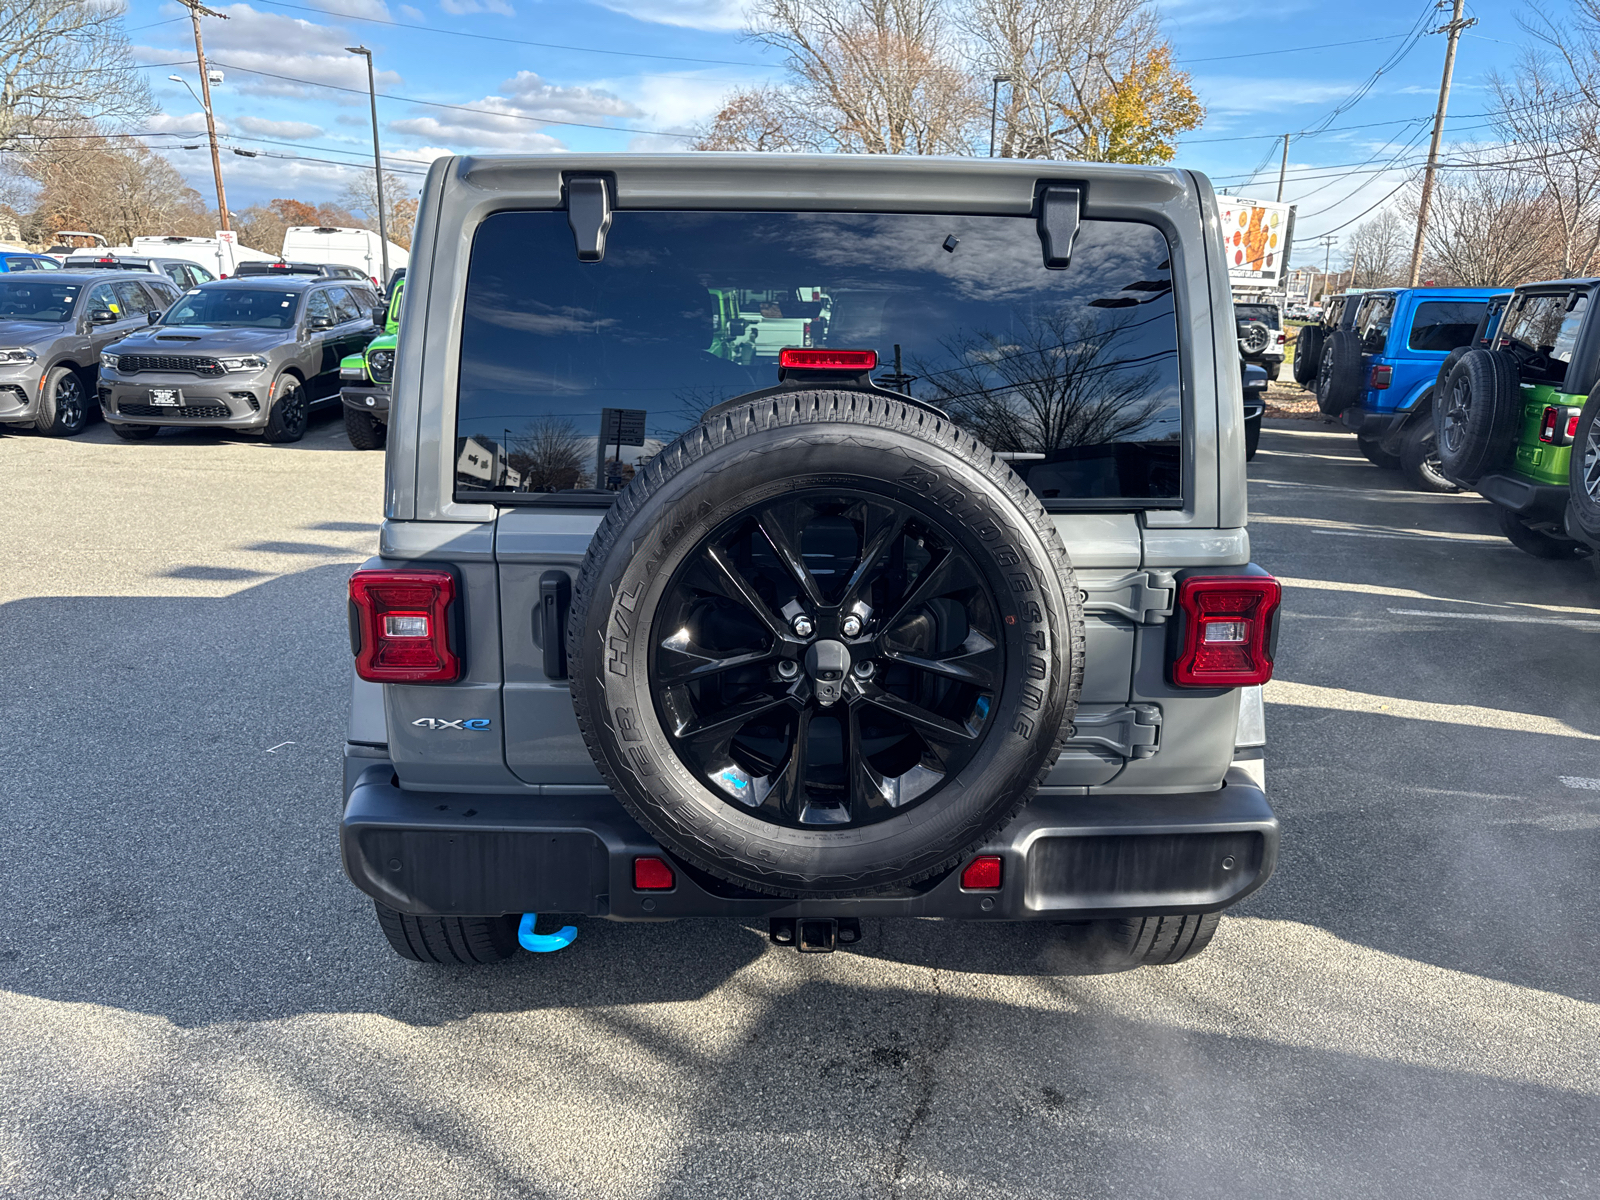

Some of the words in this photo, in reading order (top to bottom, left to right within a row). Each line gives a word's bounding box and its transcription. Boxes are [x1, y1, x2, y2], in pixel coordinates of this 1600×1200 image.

[645, 500, 713, 577] ALENZA
[608, 581, 646, 677] H/L
[898, 464, 1046, 740] BRIDGESTONE
[614, 707, 788, 864] DUELER
